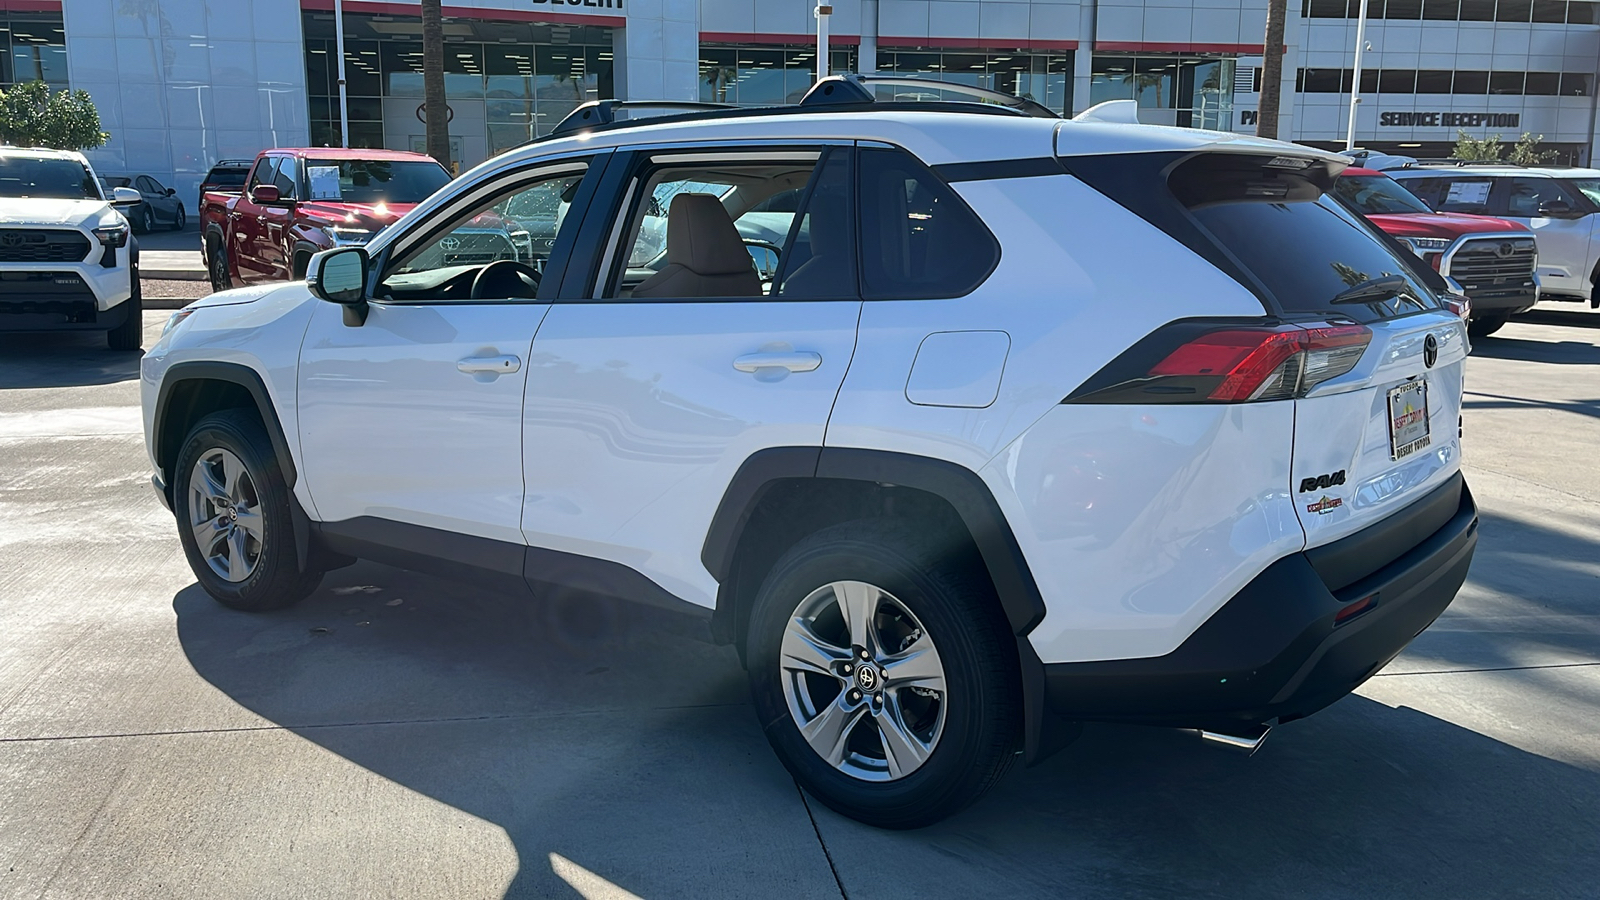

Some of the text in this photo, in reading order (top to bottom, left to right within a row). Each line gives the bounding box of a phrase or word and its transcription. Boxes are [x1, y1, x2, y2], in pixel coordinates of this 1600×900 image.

[1380, 112, 1520, 127] SERVICE RECEPTION
[1400, 382, 1419, 393] TUCSON
[1397, 436, 1431, 459] DESERT TOYOTA
[1299, 469, 1346, 493] RAV4
